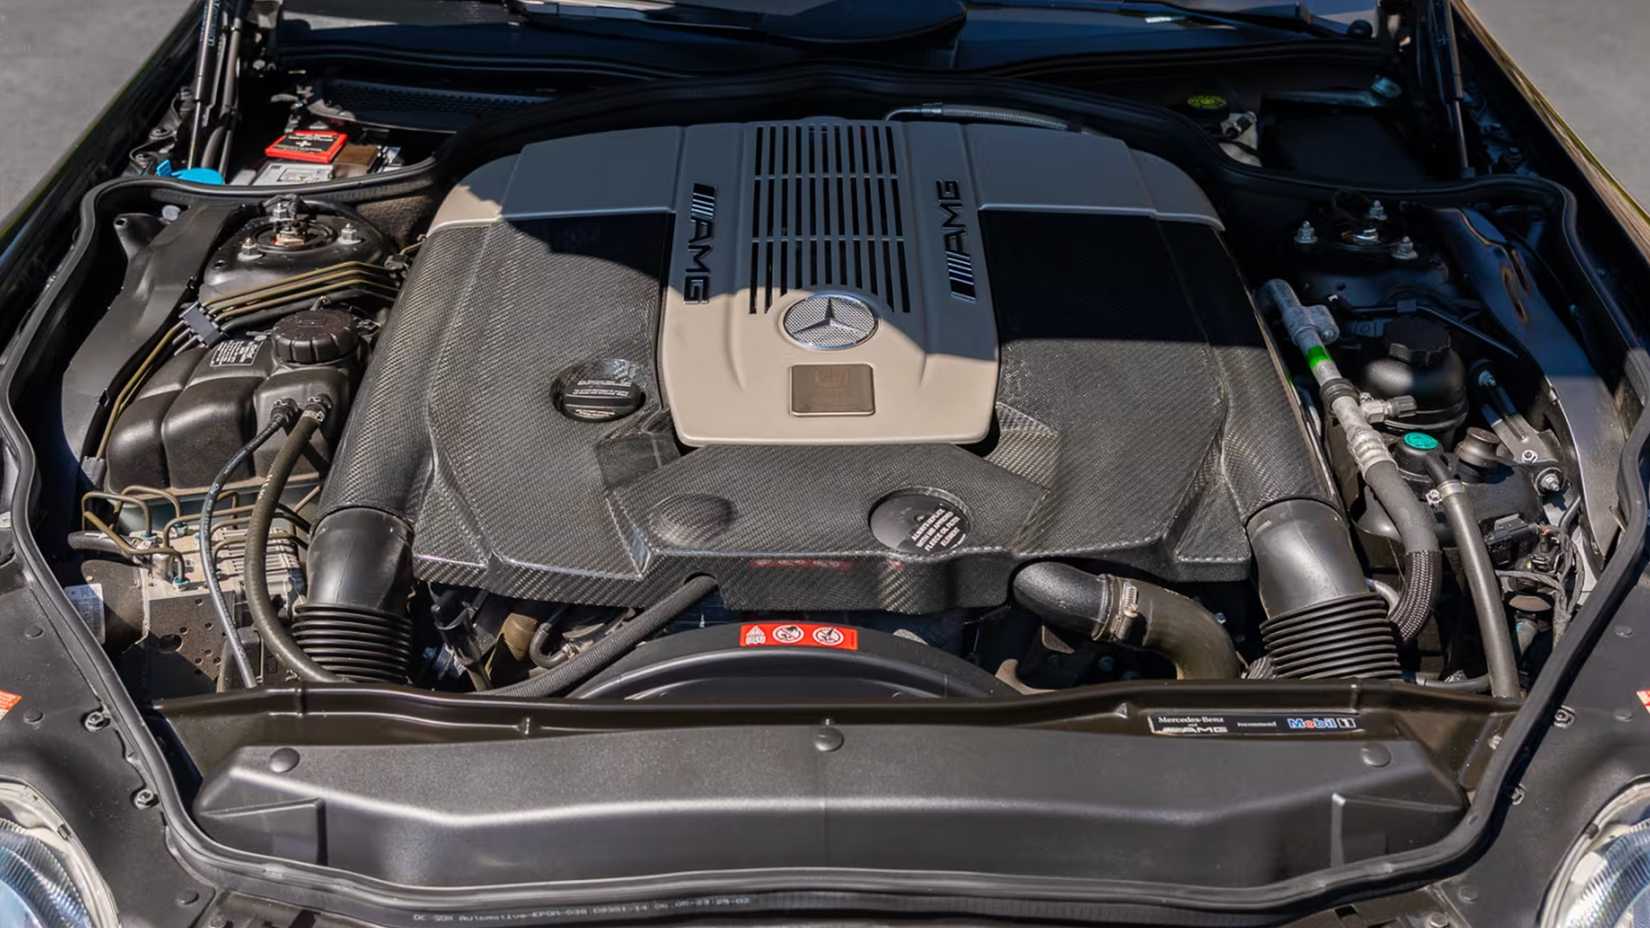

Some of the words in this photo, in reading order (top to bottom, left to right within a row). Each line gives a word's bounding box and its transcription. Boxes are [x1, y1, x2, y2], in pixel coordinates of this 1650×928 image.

[936, 179, 967, 254] AMG
[683, 216, 714, 304] AMG
[1157, 715, 1225, 724] Mercedes-Benz
[1287, 717, 1338, 729] Mobil
